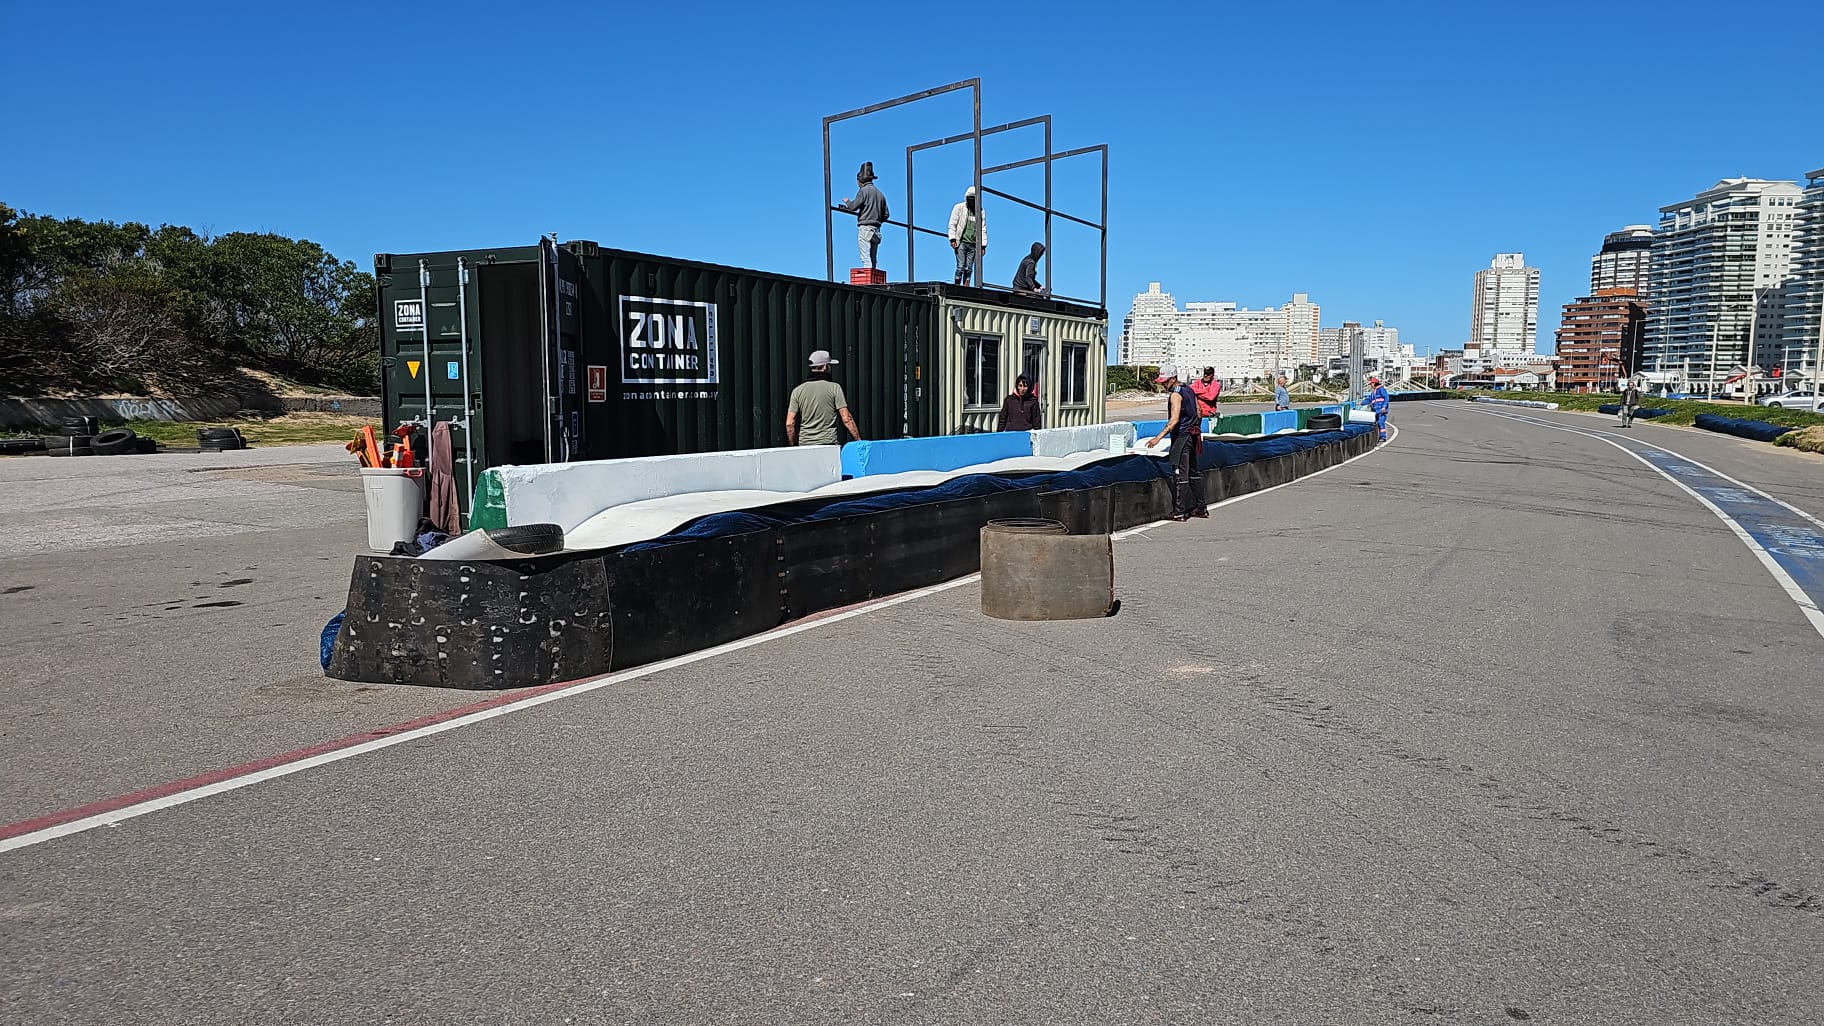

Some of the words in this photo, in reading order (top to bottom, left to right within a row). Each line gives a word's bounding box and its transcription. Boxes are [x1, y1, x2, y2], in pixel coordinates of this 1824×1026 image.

[398, 304, 421, 316] ZONA
[629, 312, 698, 350] ZONA
[629, 353, 698, 370] CONTAINER
